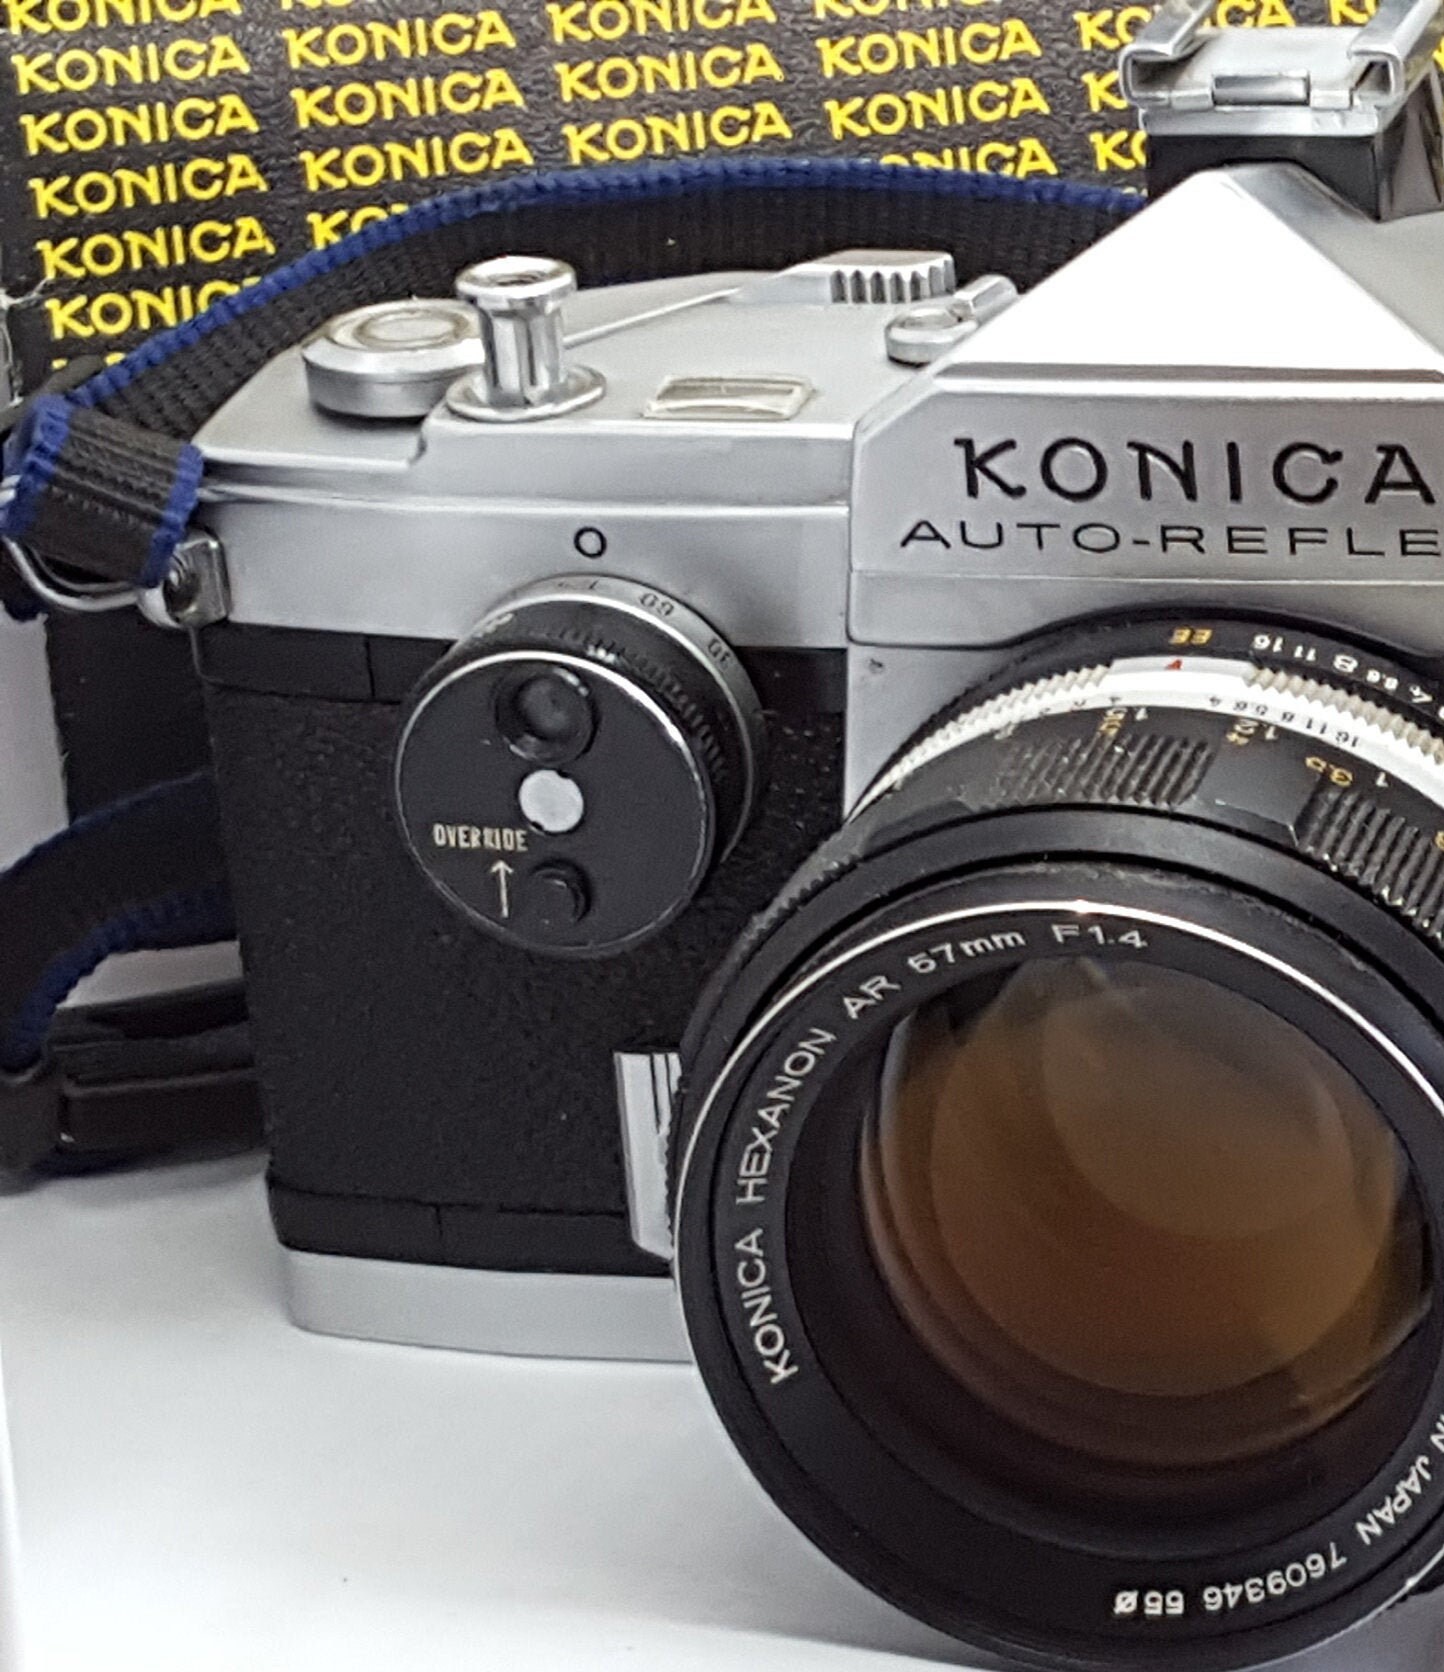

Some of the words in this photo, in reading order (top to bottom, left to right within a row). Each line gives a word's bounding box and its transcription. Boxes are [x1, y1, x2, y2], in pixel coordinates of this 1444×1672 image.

[10, 35, 250, 95] KONICA
[282, 9, 518, 69] KONICA
[19, 93, 261, 155] KONICA
[290, 67, 524, 128] KONICA
[553, 42, 786, 102] KONICA
[814, 17, 1044, 78] KONICA
[28, 153, 270, 218] KONICA
[297, 126, 534, 192] KONICA
[563, 100, 794, 163] KONICA
[823, 76, 1052, 141] KONICA
[35, 215, 277, 280] KONICA
[953, 436, 1438, 504] KONICA
[1168, 626, 1213, 646] EE
[1252, 633, 1284, 653] 16
[1293, 644, 1318, 663] 11
[1332, 653, 1359, 674] 8
[432, 821, 529, 853] OVERRIDE
[1051, 923, 1149, 949] F1.4
[841, 974, 901, 1020] AR
[735, 1027, 837, 1205] HEXANON
[734, 1227, 799, 1385] KONICA
[1354, 1455, 1433, 1546] JAPAN
[1201, 1541, 1348, 1612] 7609346
